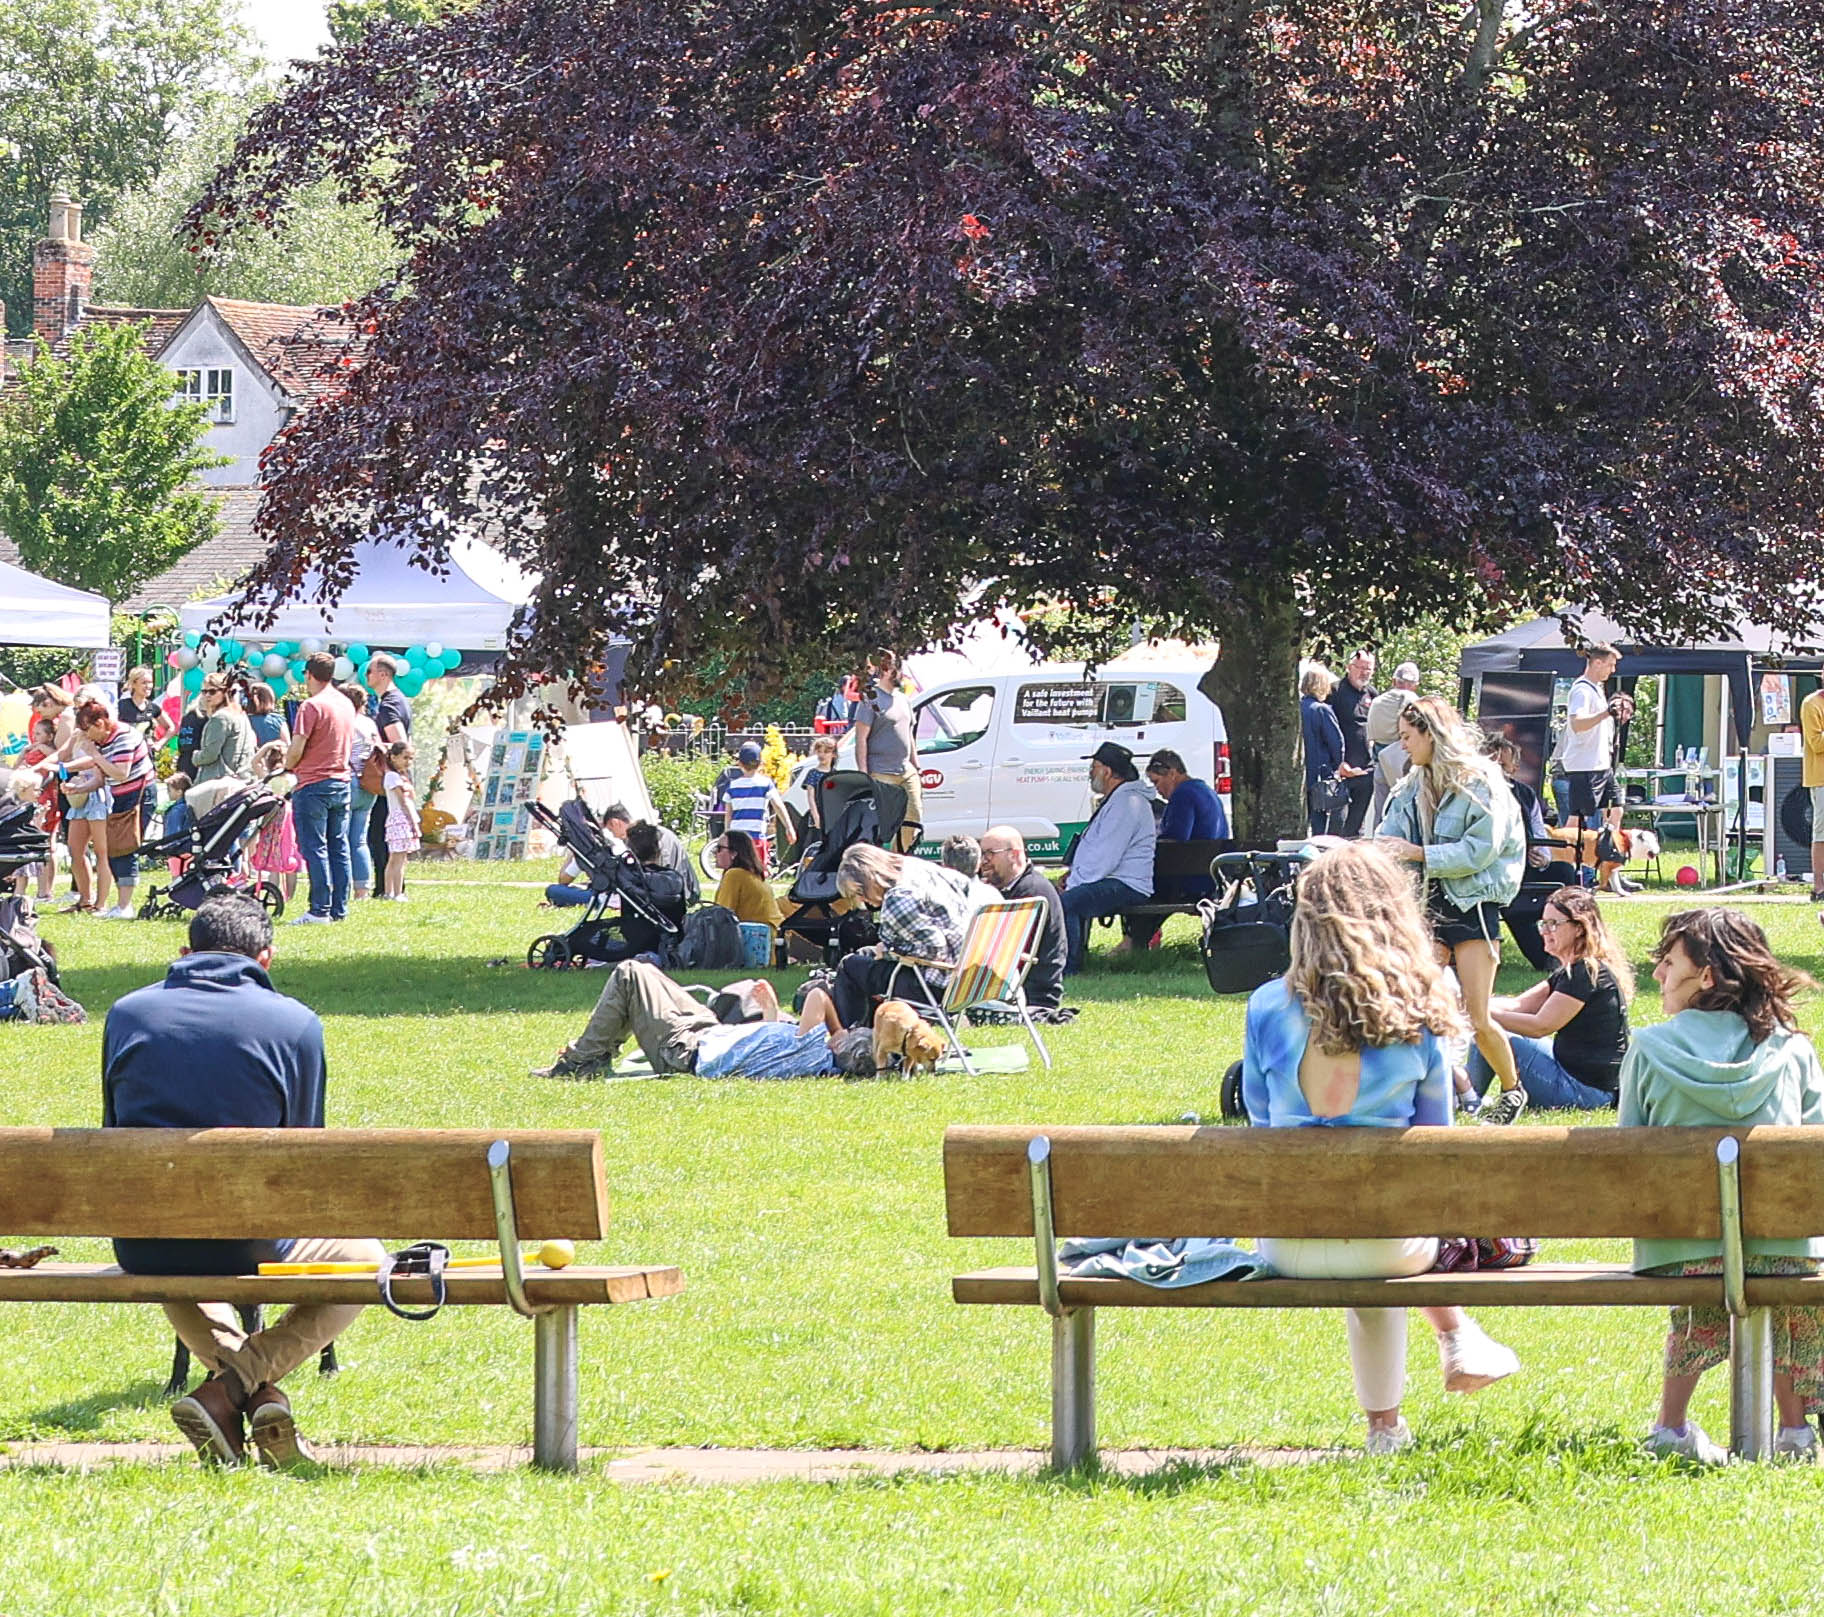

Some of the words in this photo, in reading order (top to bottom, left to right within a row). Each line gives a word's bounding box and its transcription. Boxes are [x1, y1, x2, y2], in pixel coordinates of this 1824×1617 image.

[1024, 689, 1030, 698] A
[1032, 689, 1048, 698] safe
[1050, 688, 1094, 697] investment
[1023, 699, 1034, 707] for
[1036, 698, 1048, 707] the
[1050, 698, 1074, 707] future
[1076, 698, 1094, 706] with
[1053, 708, 1070, 717] heat
[1071, 708, 1098, 718] pumps
